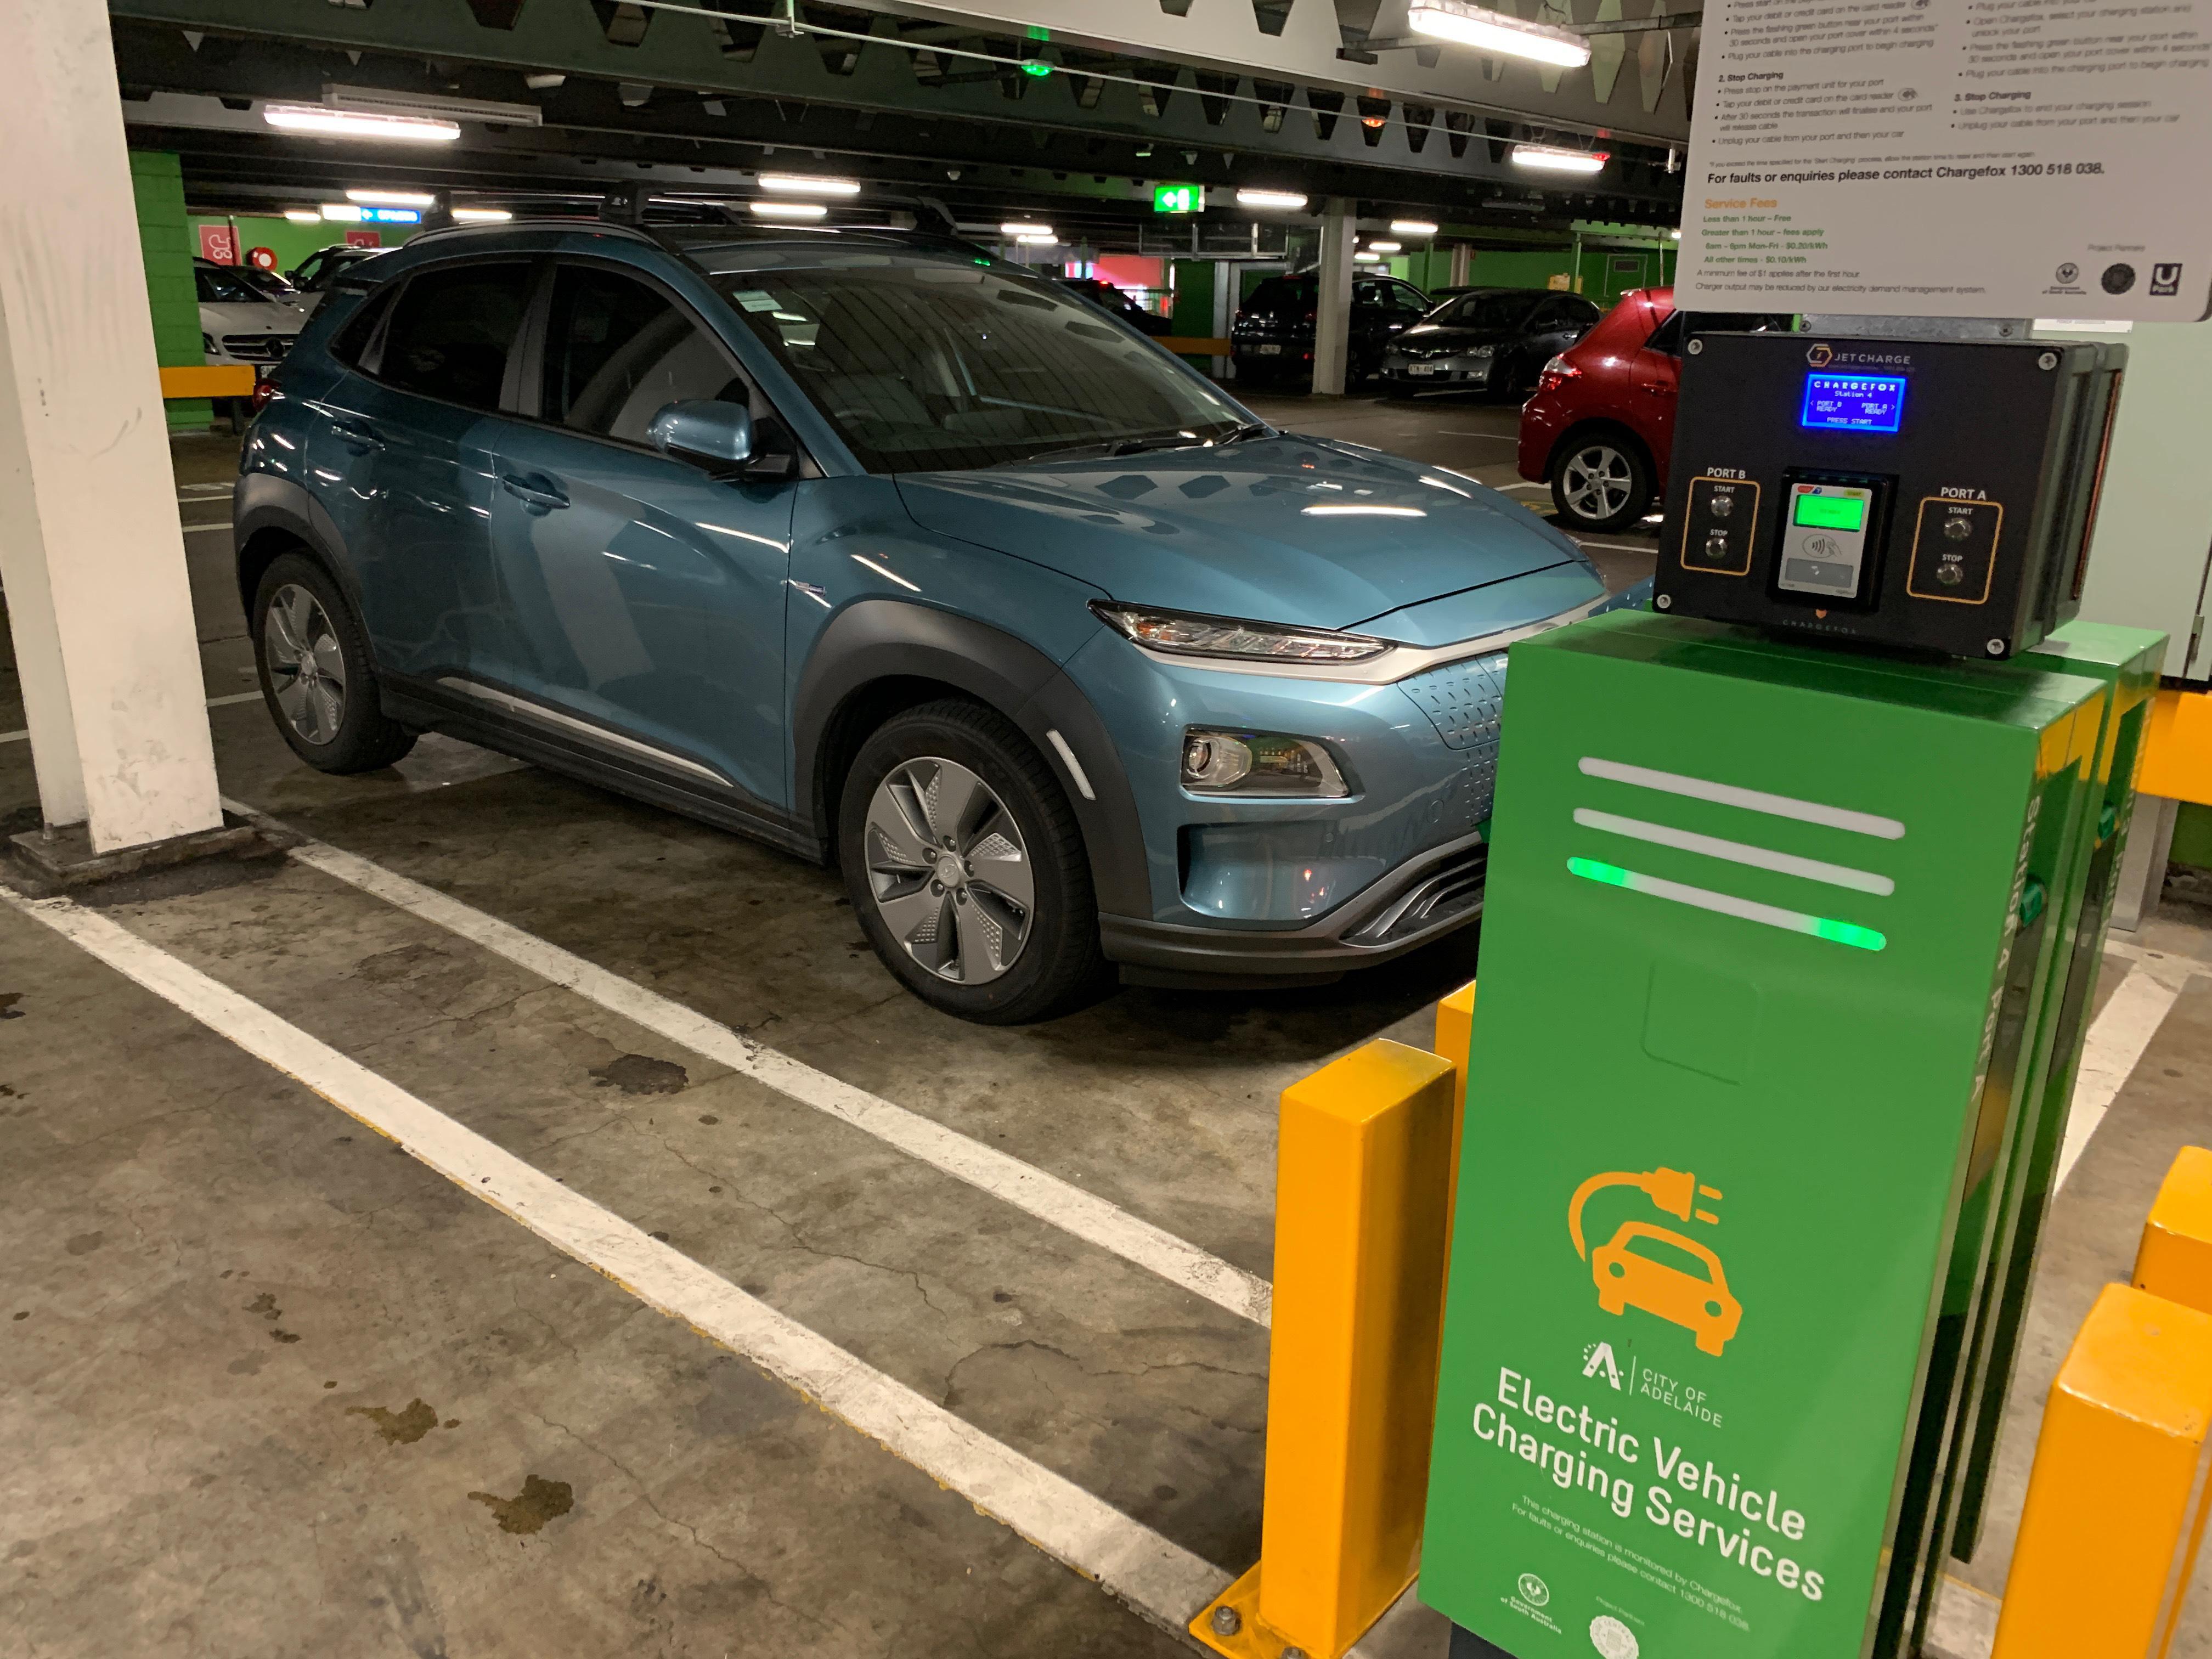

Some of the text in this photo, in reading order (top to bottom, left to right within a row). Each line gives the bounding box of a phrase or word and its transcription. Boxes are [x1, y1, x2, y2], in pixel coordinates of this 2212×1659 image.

[1747, 72, 1784, 80] Charging
[1988, 92, 2031, 100] Charging
[1708, 173, 1726, 183] For
[1730, 173, 1761, 183] faults
[1780, 171, 1835, 182] enquiries
[1838, 170, 1880, 182] please
[1883, 168, 1933, 179] contact
[1936, 166, 2006, 178] Chargefox
[2012, 165, 2043, 176] 1300
[2046, 165, 2072, 175] 518
[2076, 164, 2104, 174] 038.
[1705, 198, 1778, 208] Service Fees
[1696, 283, 1723, 291] Charger
[1814, 381, 1895, 392] CHARGEFOX
[1707, 467, 1746, 479] PORT B
[1940, 487, 1986, 500] PORT A
[2005, 795, 2040, 936] Station
[1643, 1368, 1707, 1403] CITY OF
[1640, 1383, 1722, 1428] ADELAIDE
[1497, 1367, 1805, 1541] Electric Vehicle
[1473, 1403, 1825, 1601] Charging Services
[1523, 1495, 1539, 1510] This
[1542, 1508, 1580, 1532] charging
[1583, 1527, 1612, 1547] station
[1624, 1548, 1673, 1578] monitored
[1675, 1572, 1687, 1585] by
[1513, 1503, 1526, 1516] For
[1529, 1512, 1551, 1530] faults
[1554, 1526, 1562, 1534] or
[1565, 1532, 1605, 1557] enquiries
[1607, 1554, 1638, 1573] please
[1640, 1571, 1676, 1593] contact
[1680, 1589, 1705, 1607] 1300
[1510, 1601, 1529, 1616] South
[1531, 1613, 1561, 1634] Australia
[1511, 1596, 1553, 1622] Government
